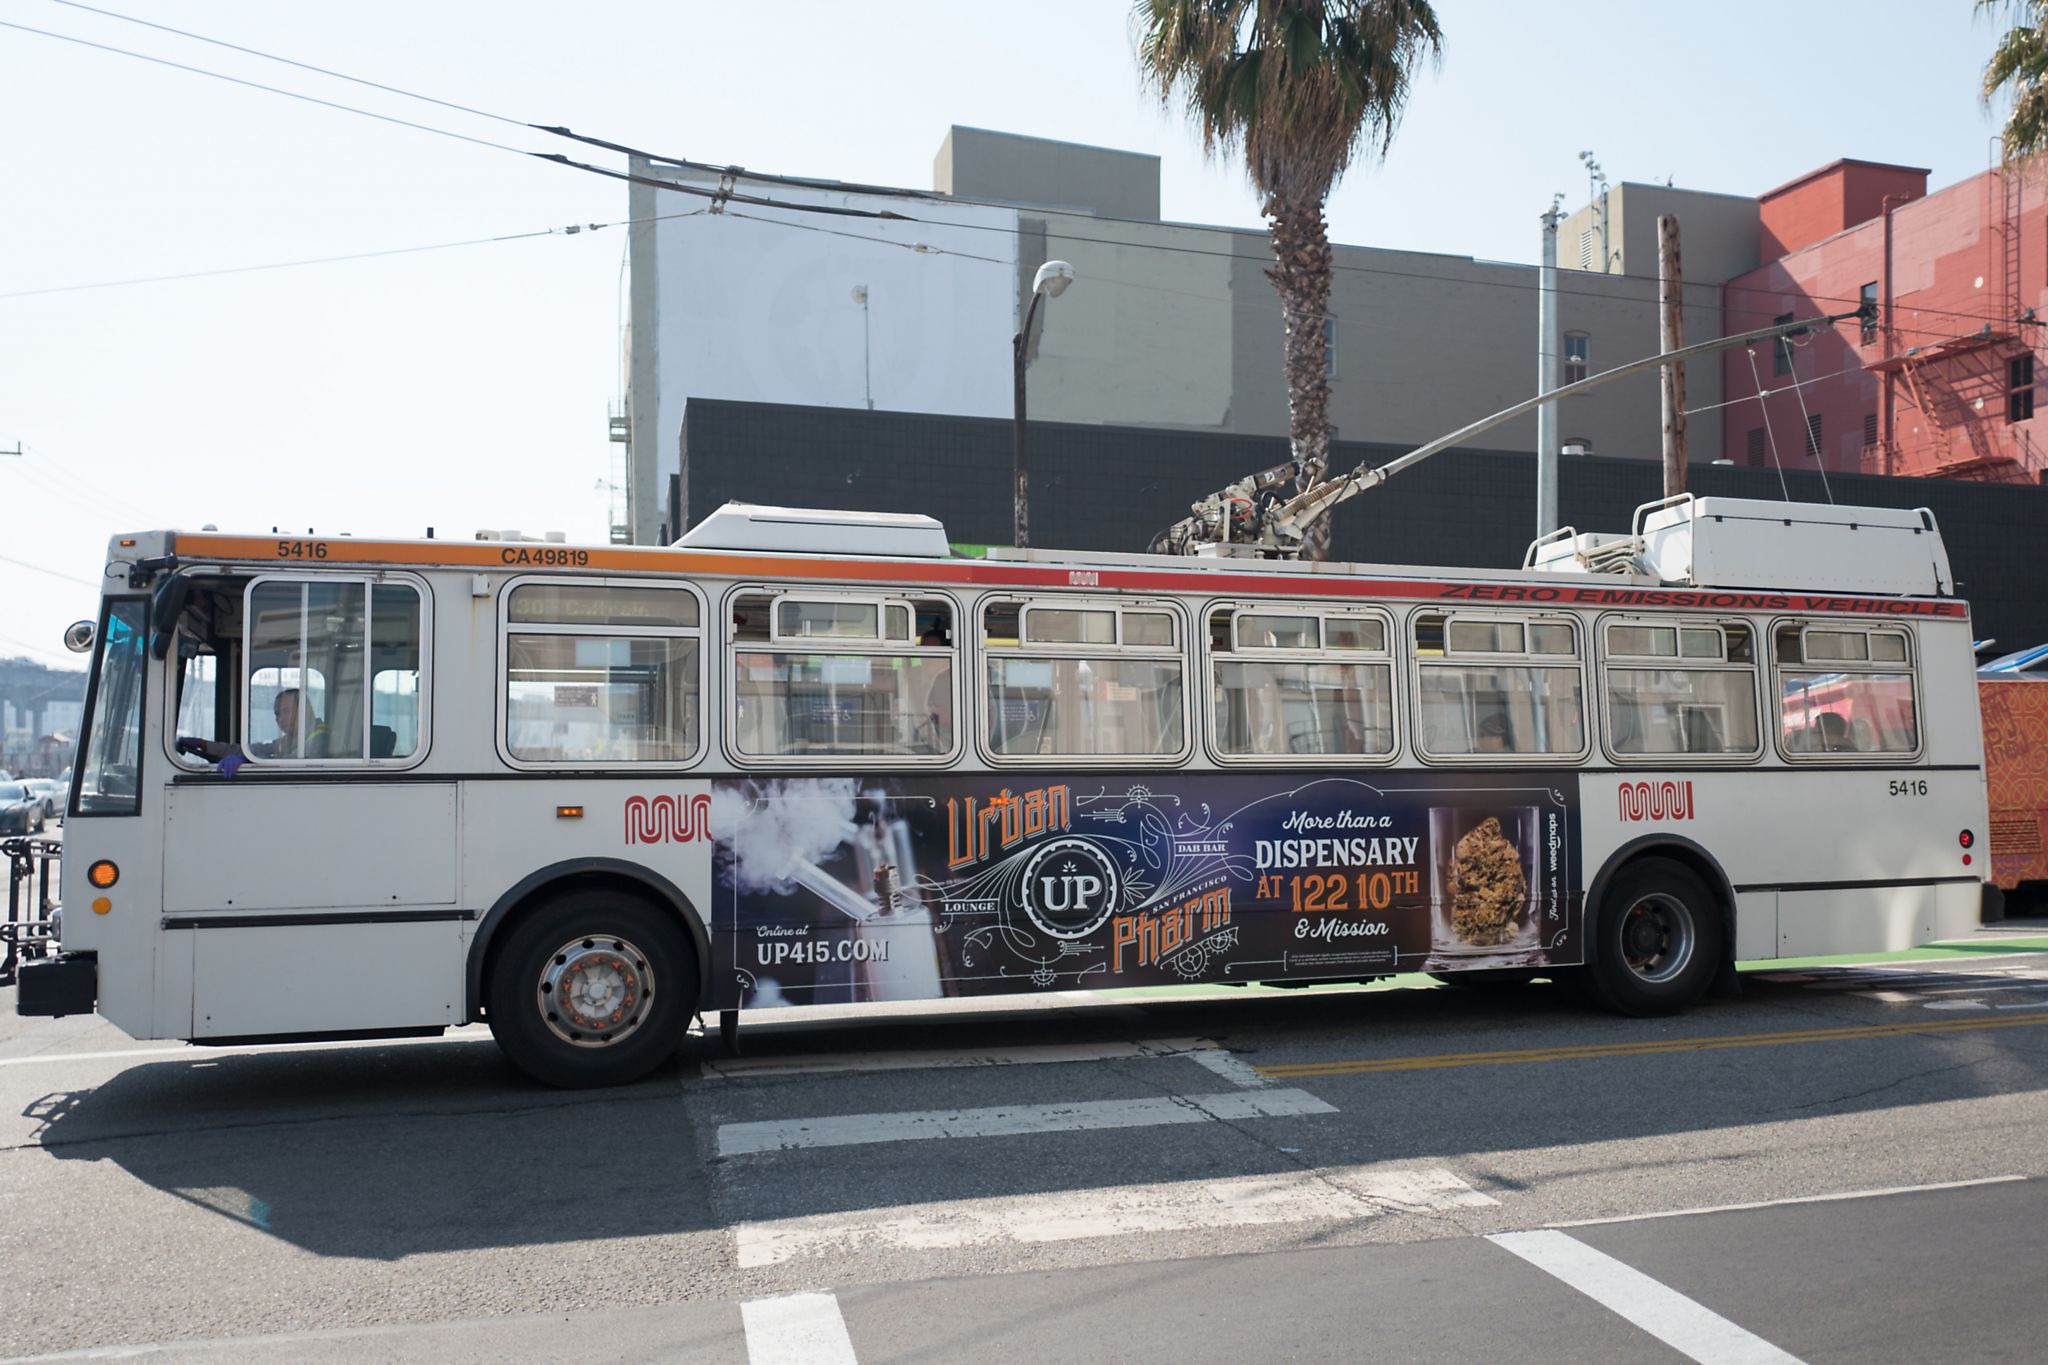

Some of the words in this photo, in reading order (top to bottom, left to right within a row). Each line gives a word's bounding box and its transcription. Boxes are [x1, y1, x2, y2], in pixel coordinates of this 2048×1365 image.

[278, 541, 327, 558] 5416
[501, 548, 588, 565] CA49819
[1440, 584, 1560, 601] ZERO
[1574, 588, 1790, 608] EMISSIONS
[1801, 597, 1954, 615] VEHICLE
[1889, 780, 1928, 796] 5416
[947, 784, 1072, 871] Urban
[1282, 810, 1335, 834] More
[1336, 810, 1378, 829] than
[1379, 815, 1393, 828] a
[1178, 844, 1201, 853] DAB
[1203, 843, 1226, 852] BAR
[1255, 836, 1419, 869] DISPENSARY
[1549, 813, 1560, 872] weedmaps
[1040, 875, 1103, 912] UP
[1152, 901, 1170, 915] SAN
[1172, 874, 1228, 904] FRANCISCO
[1255, 875, 1284, 899] AT
[1290, 874, 1348, 912] 122
[1355, 871, 1419, 910] 10TH
[1551, 876, 1557, 888] on
[945, 902, 996, 912] LOUNGE
[1549, 898, 1559, 920] Find
[756, 925, 795, 937] Online
[795, 924, 809, 935] at
[1112, 886, 1232, 974] Pharm
[1294, 918, 1310, 938] &
[1310, 918, 1389, 943] Mission
[757, 940, 889, 965] UP415.COM
